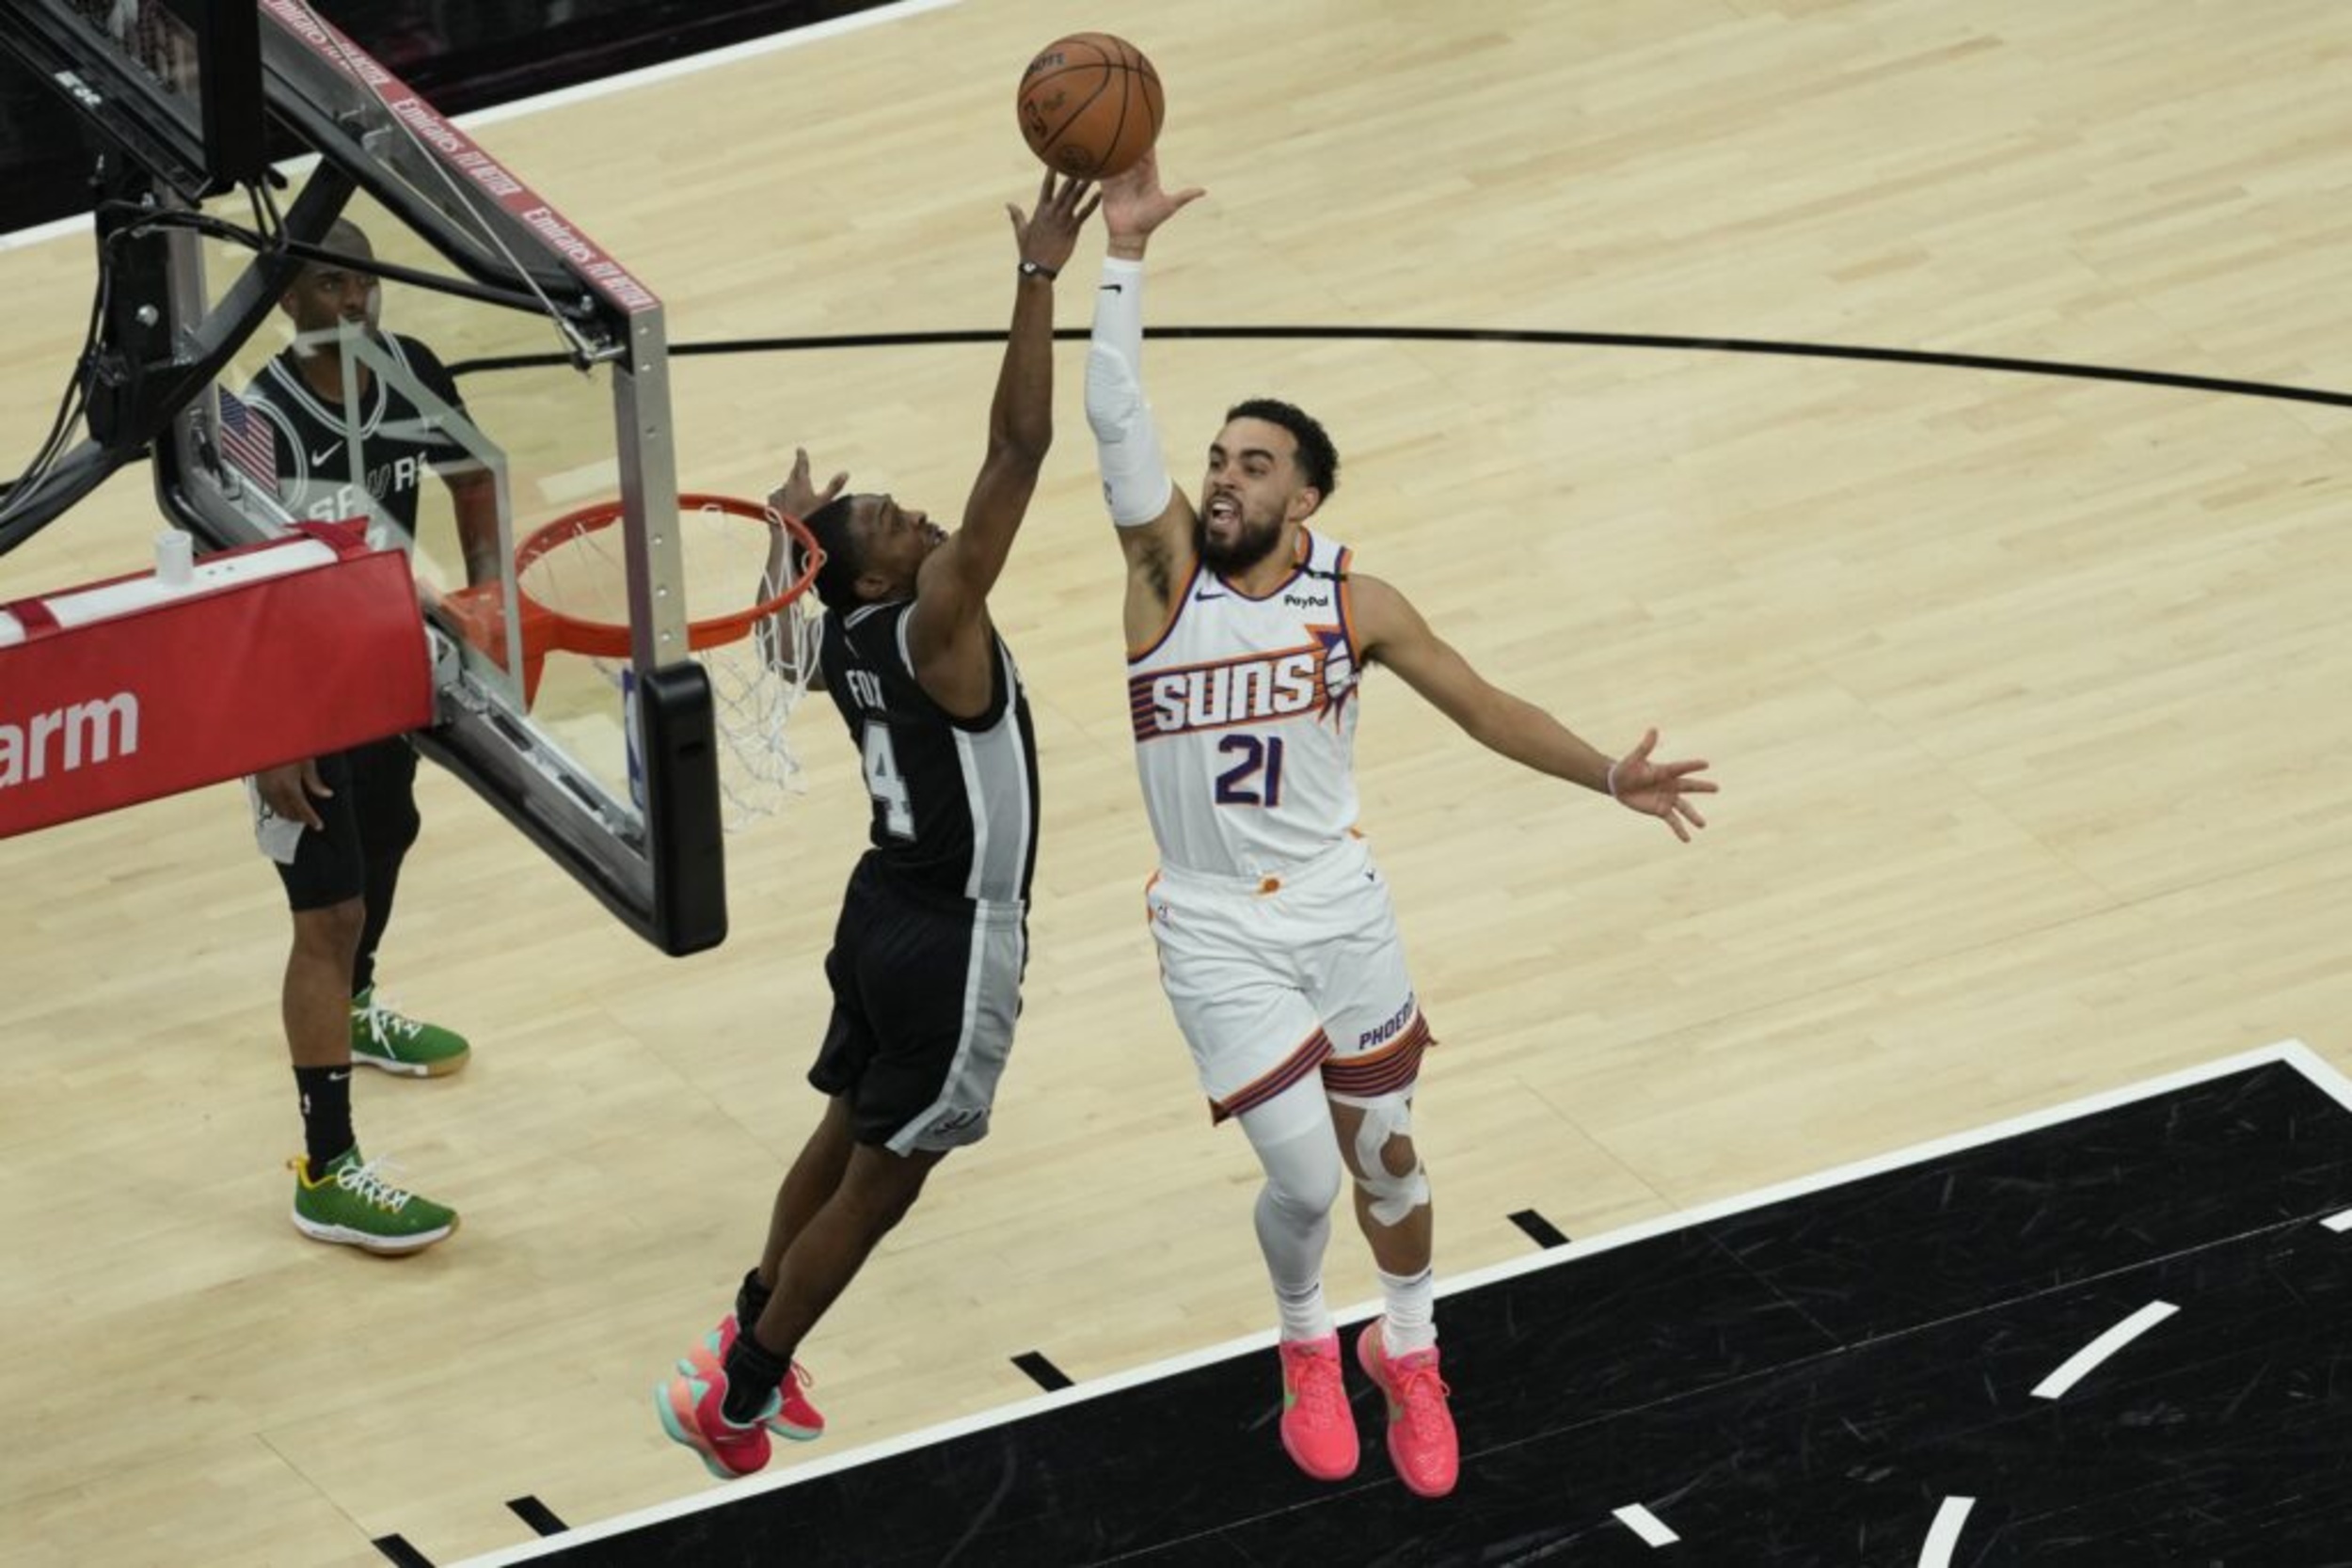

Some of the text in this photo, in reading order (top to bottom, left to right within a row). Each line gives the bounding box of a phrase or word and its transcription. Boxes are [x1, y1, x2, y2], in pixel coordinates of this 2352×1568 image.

[1284, 594, 1328, 610] PayPal
[846, 670, 887, 713] FOX
[1152, 655, 1314, 731] SUNS
[863, 719, 915, 840] 4
[1216, 734, 1283, 808] 21
